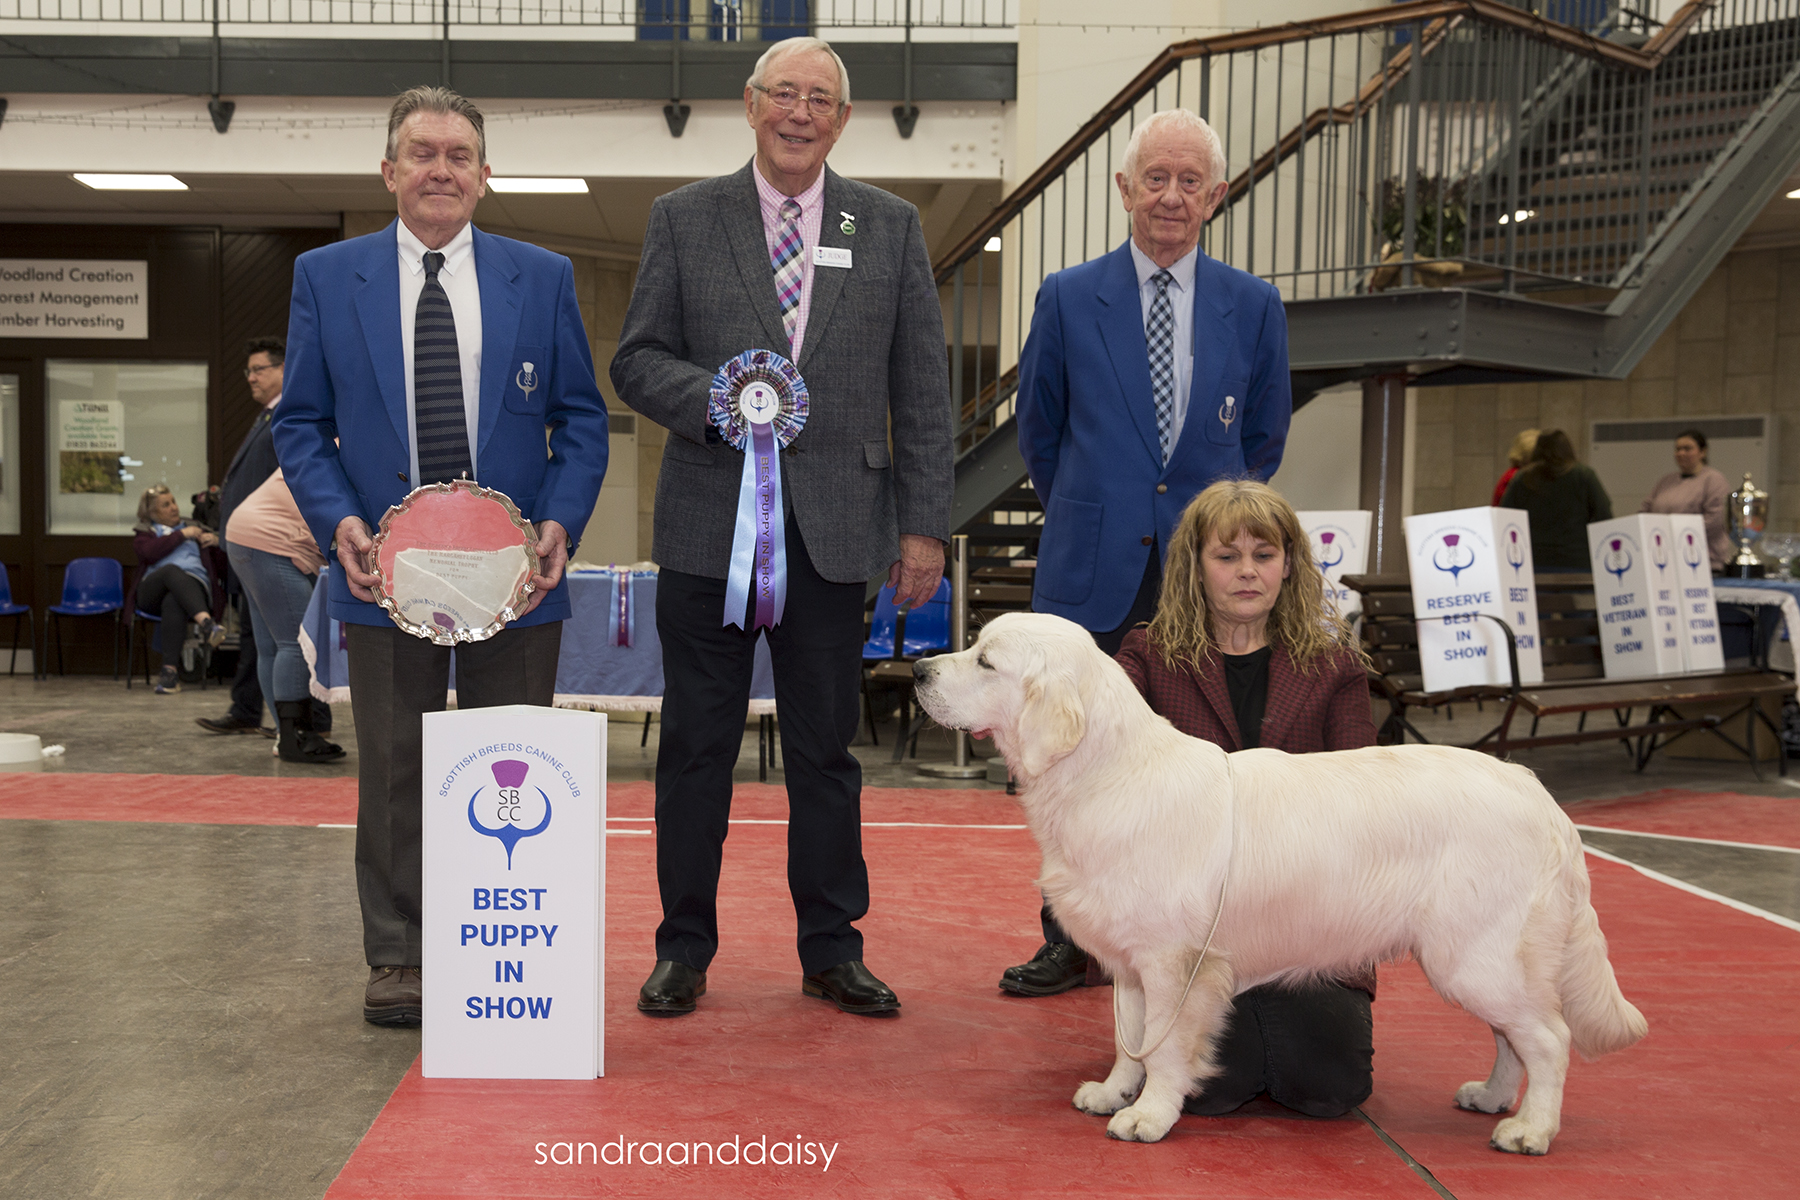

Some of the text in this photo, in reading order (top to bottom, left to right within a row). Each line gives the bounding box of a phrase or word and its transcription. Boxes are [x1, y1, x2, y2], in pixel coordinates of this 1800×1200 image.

[0, 267, 134, 282] oodland Creation
[0, 291, 139, 308] orest Management
[0, 312, 124, 331] mber Harvesting
[761, 456, 770, 598] BEST PUPPY IN SHOW
[1427, 591, 1492, 610] RESERVE
[1509, 587, 1528, 602] BEST
[1610, 592, 1634, 607] BEST
[1443, 610, 1480, 626] BEST
[1517, 611, 1525, 625] IN
[1602, 608, 1647, 624] VETERAN
[1456, 630, 1471, 642] IN
[1621, 626, 1632, 637] IN
[1444, 645, 1488, 661] SHOW
[1614, 640, 1643, 654] SHOW
[438, 742, 581, 798] SCOTTISH BREEDS CANINE CLUB
[498, 789, 520, 805] SB
[497, 806, 521, 822] CC
[473, 888, 547, 911] BEST
[460, 924, 559, 947] PUPPY
[495, 960, 523, 983] IN
[465, 996, 552, 1019] SHOW
